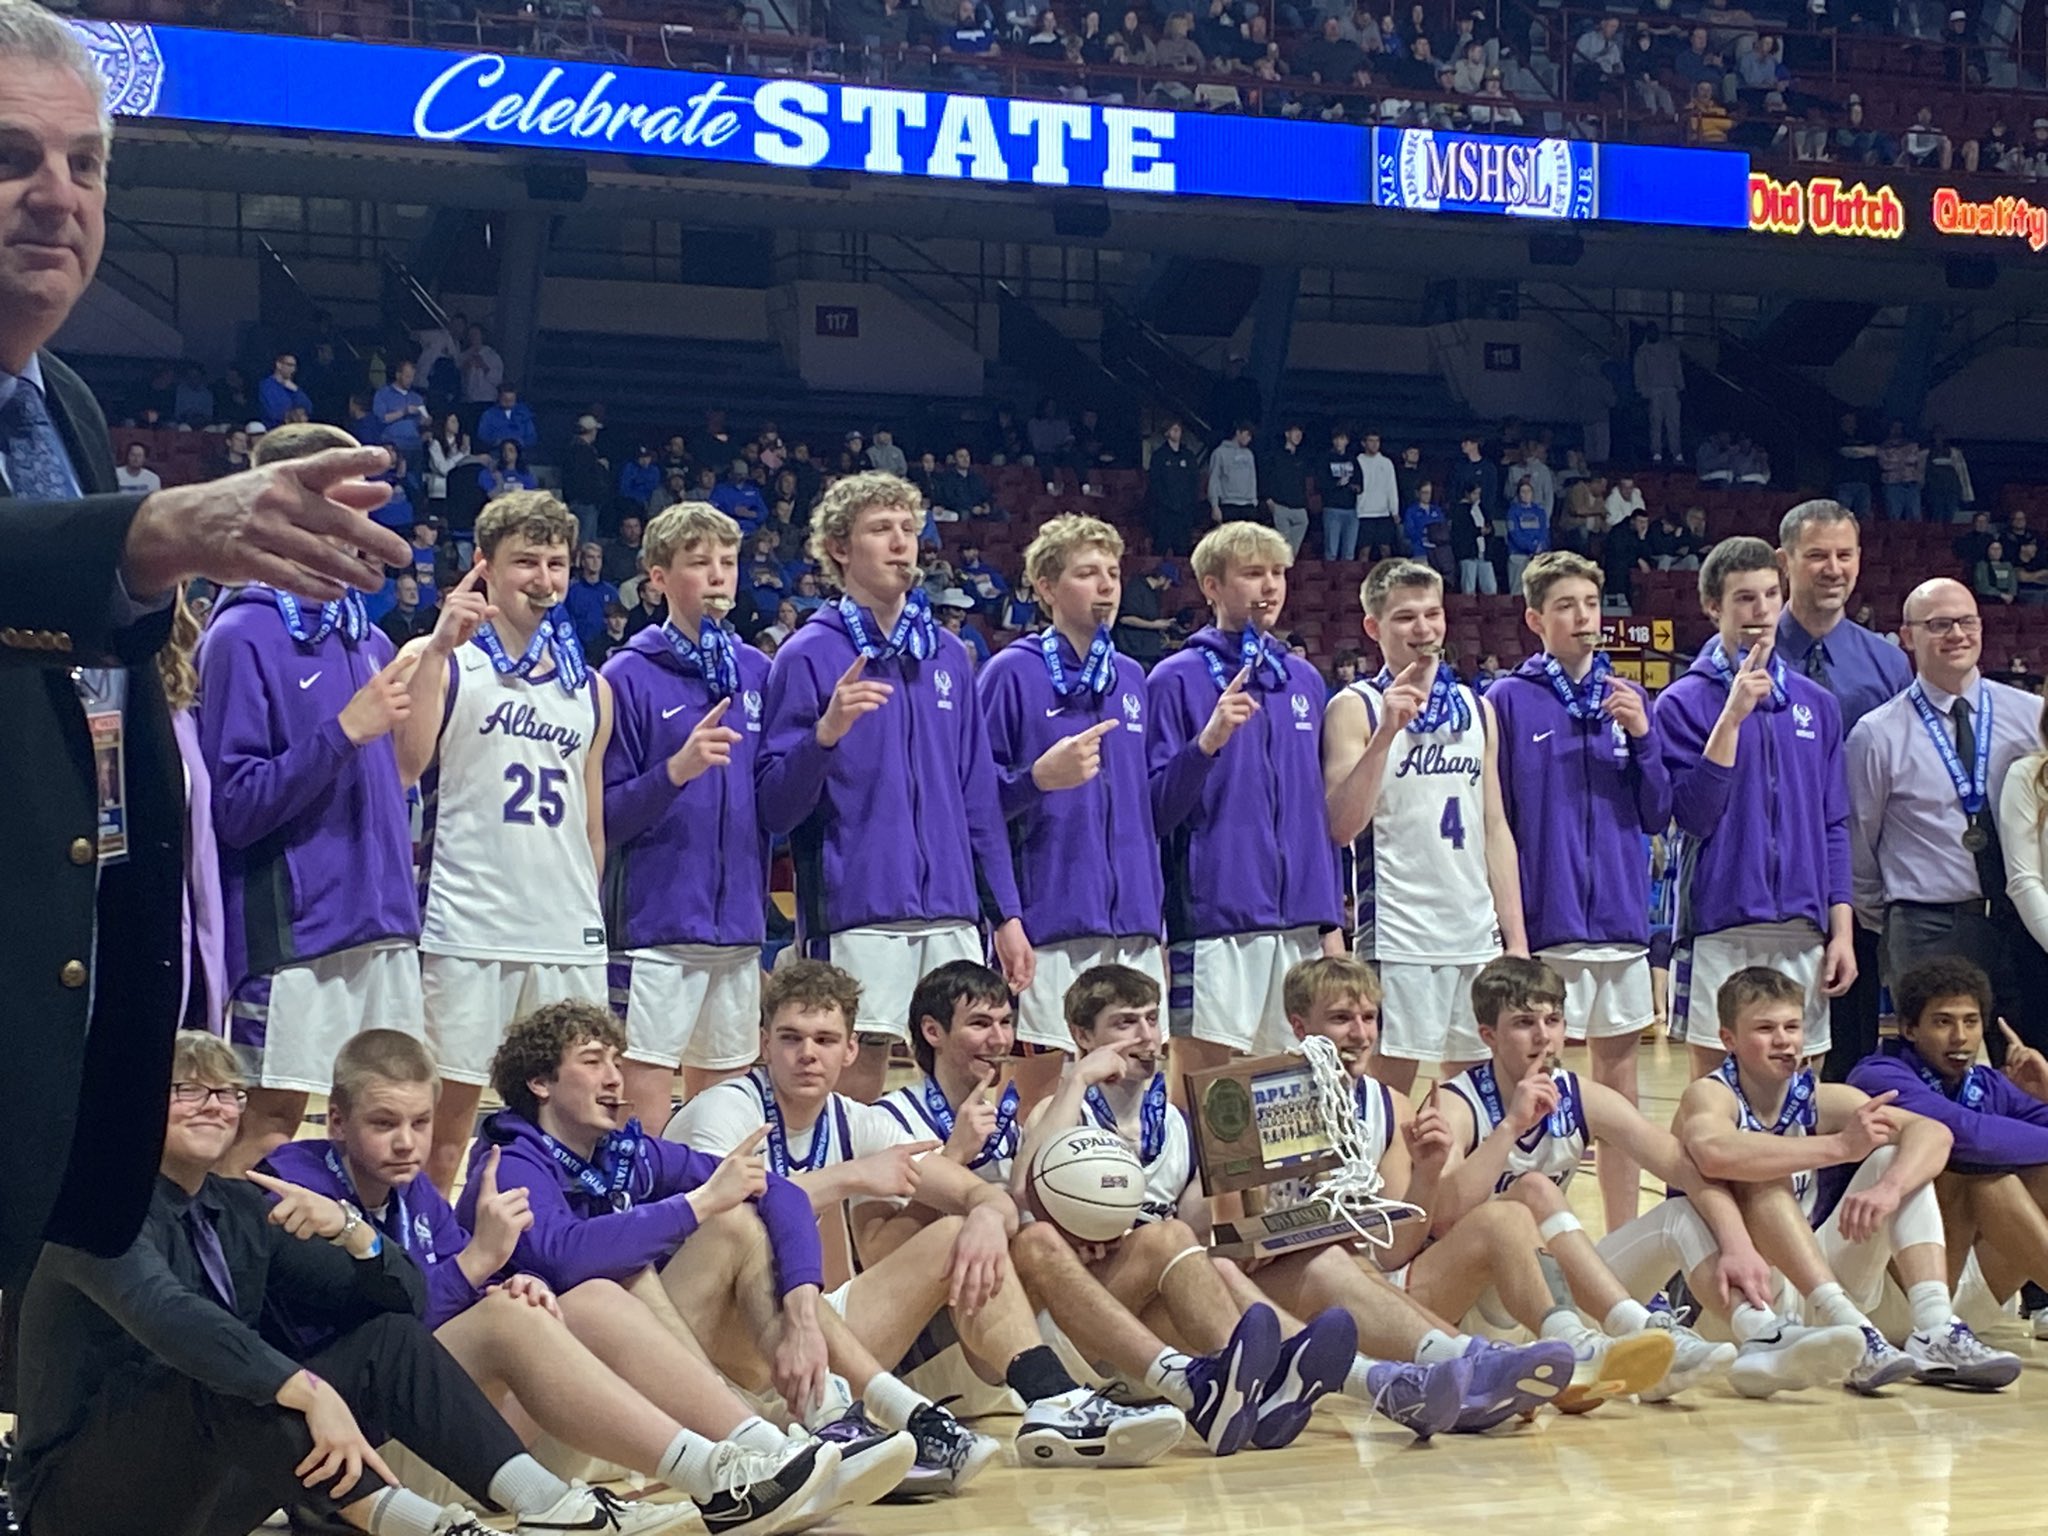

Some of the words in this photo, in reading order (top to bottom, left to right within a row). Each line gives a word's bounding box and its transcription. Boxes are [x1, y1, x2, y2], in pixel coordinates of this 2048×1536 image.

[414, 53, 742, 147] Celebrate
[754, 80, 1176, 192] STATE
[1425, 139, 1551, 207] MSHSL
[1749, 173, 1803, 234] Old
[1808, 178, 1904, 239] Dutch
[1933, 188, 2047, 252] Quality
[825, 313, 849, 330] 117
[1628, 626, 1650, 643] 118
[479, 701, 581, 759] Albany
[1395, 744, 1482, 787] Albany
[503, 762, 568, 828] 25
[1440, 796, 1466, 850] 4
[553, 1148, 582, 1173] STATE
[612, 1158, 630, 1190] STATE
